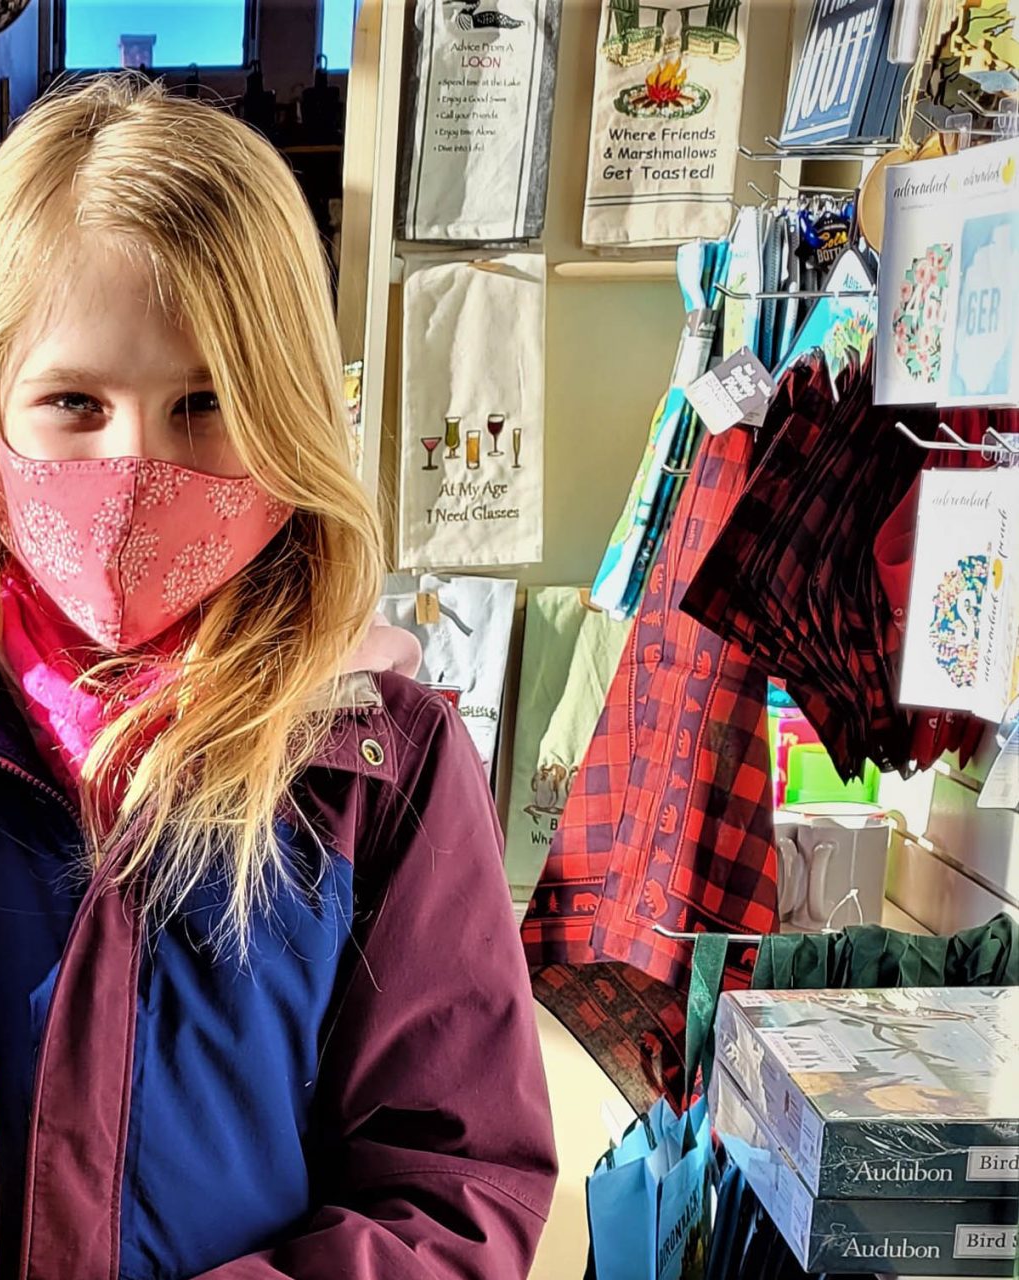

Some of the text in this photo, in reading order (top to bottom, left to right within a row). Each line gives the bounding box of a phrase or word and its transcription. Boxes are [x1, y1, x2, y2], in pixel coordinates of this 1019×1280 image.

[451, 38, 480, 52] Advice
[461, 55, 501, 68] LOON
[609, 127, 716, 141] Where Friends
[603, 146, 717, 160] & Marshmallows
[603, 163, 715, 181] Get Toasted!
[438, 481, 508, 500] At My Age
[426, 504, 520, 524] I Need Glasses
[854, 1155, 1019, 1182] Audubon Bird
[842, 1236, 940, 1259] Audubon
[967, 1233, 1006, 1249] Bird
